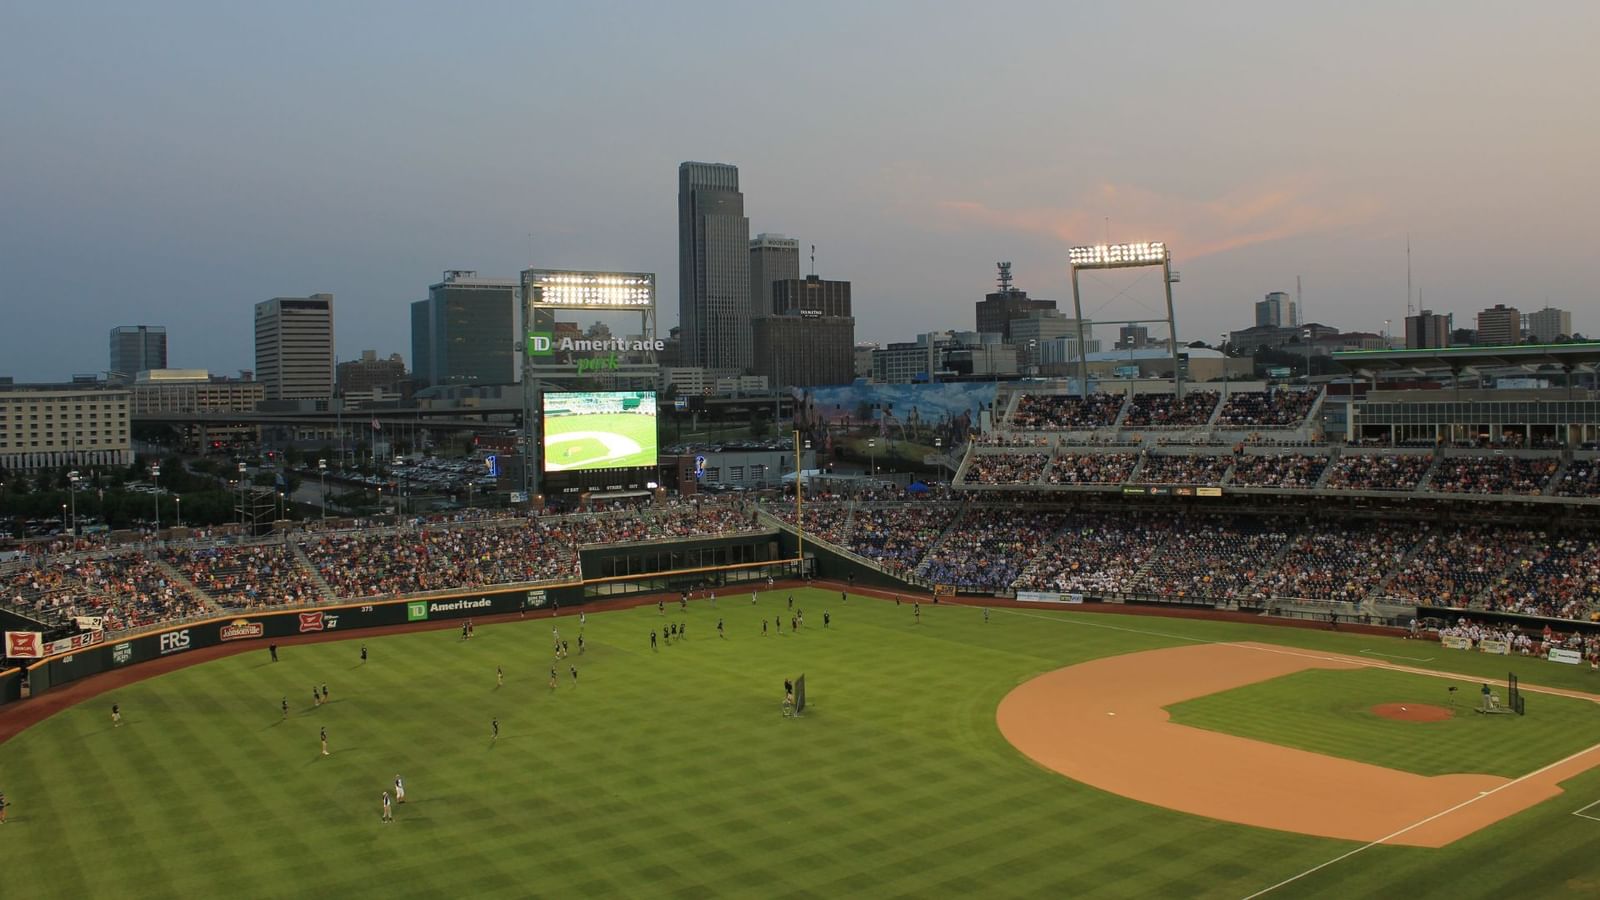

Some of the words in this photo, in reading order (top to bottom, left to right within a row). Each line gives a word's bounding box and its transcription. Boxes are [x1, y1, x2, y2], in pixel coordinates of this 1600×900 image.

[529, 336, 551, 351] TD
[559, 336, 665, 351] Ameritrade
[577, 352, 619, 376] park
[409, 604, 426, 617] TD
[430, 597, 492, 612] Ameritrade
[82, 633, 92, 645] 21
[160, 629, 190, 650] FRS
